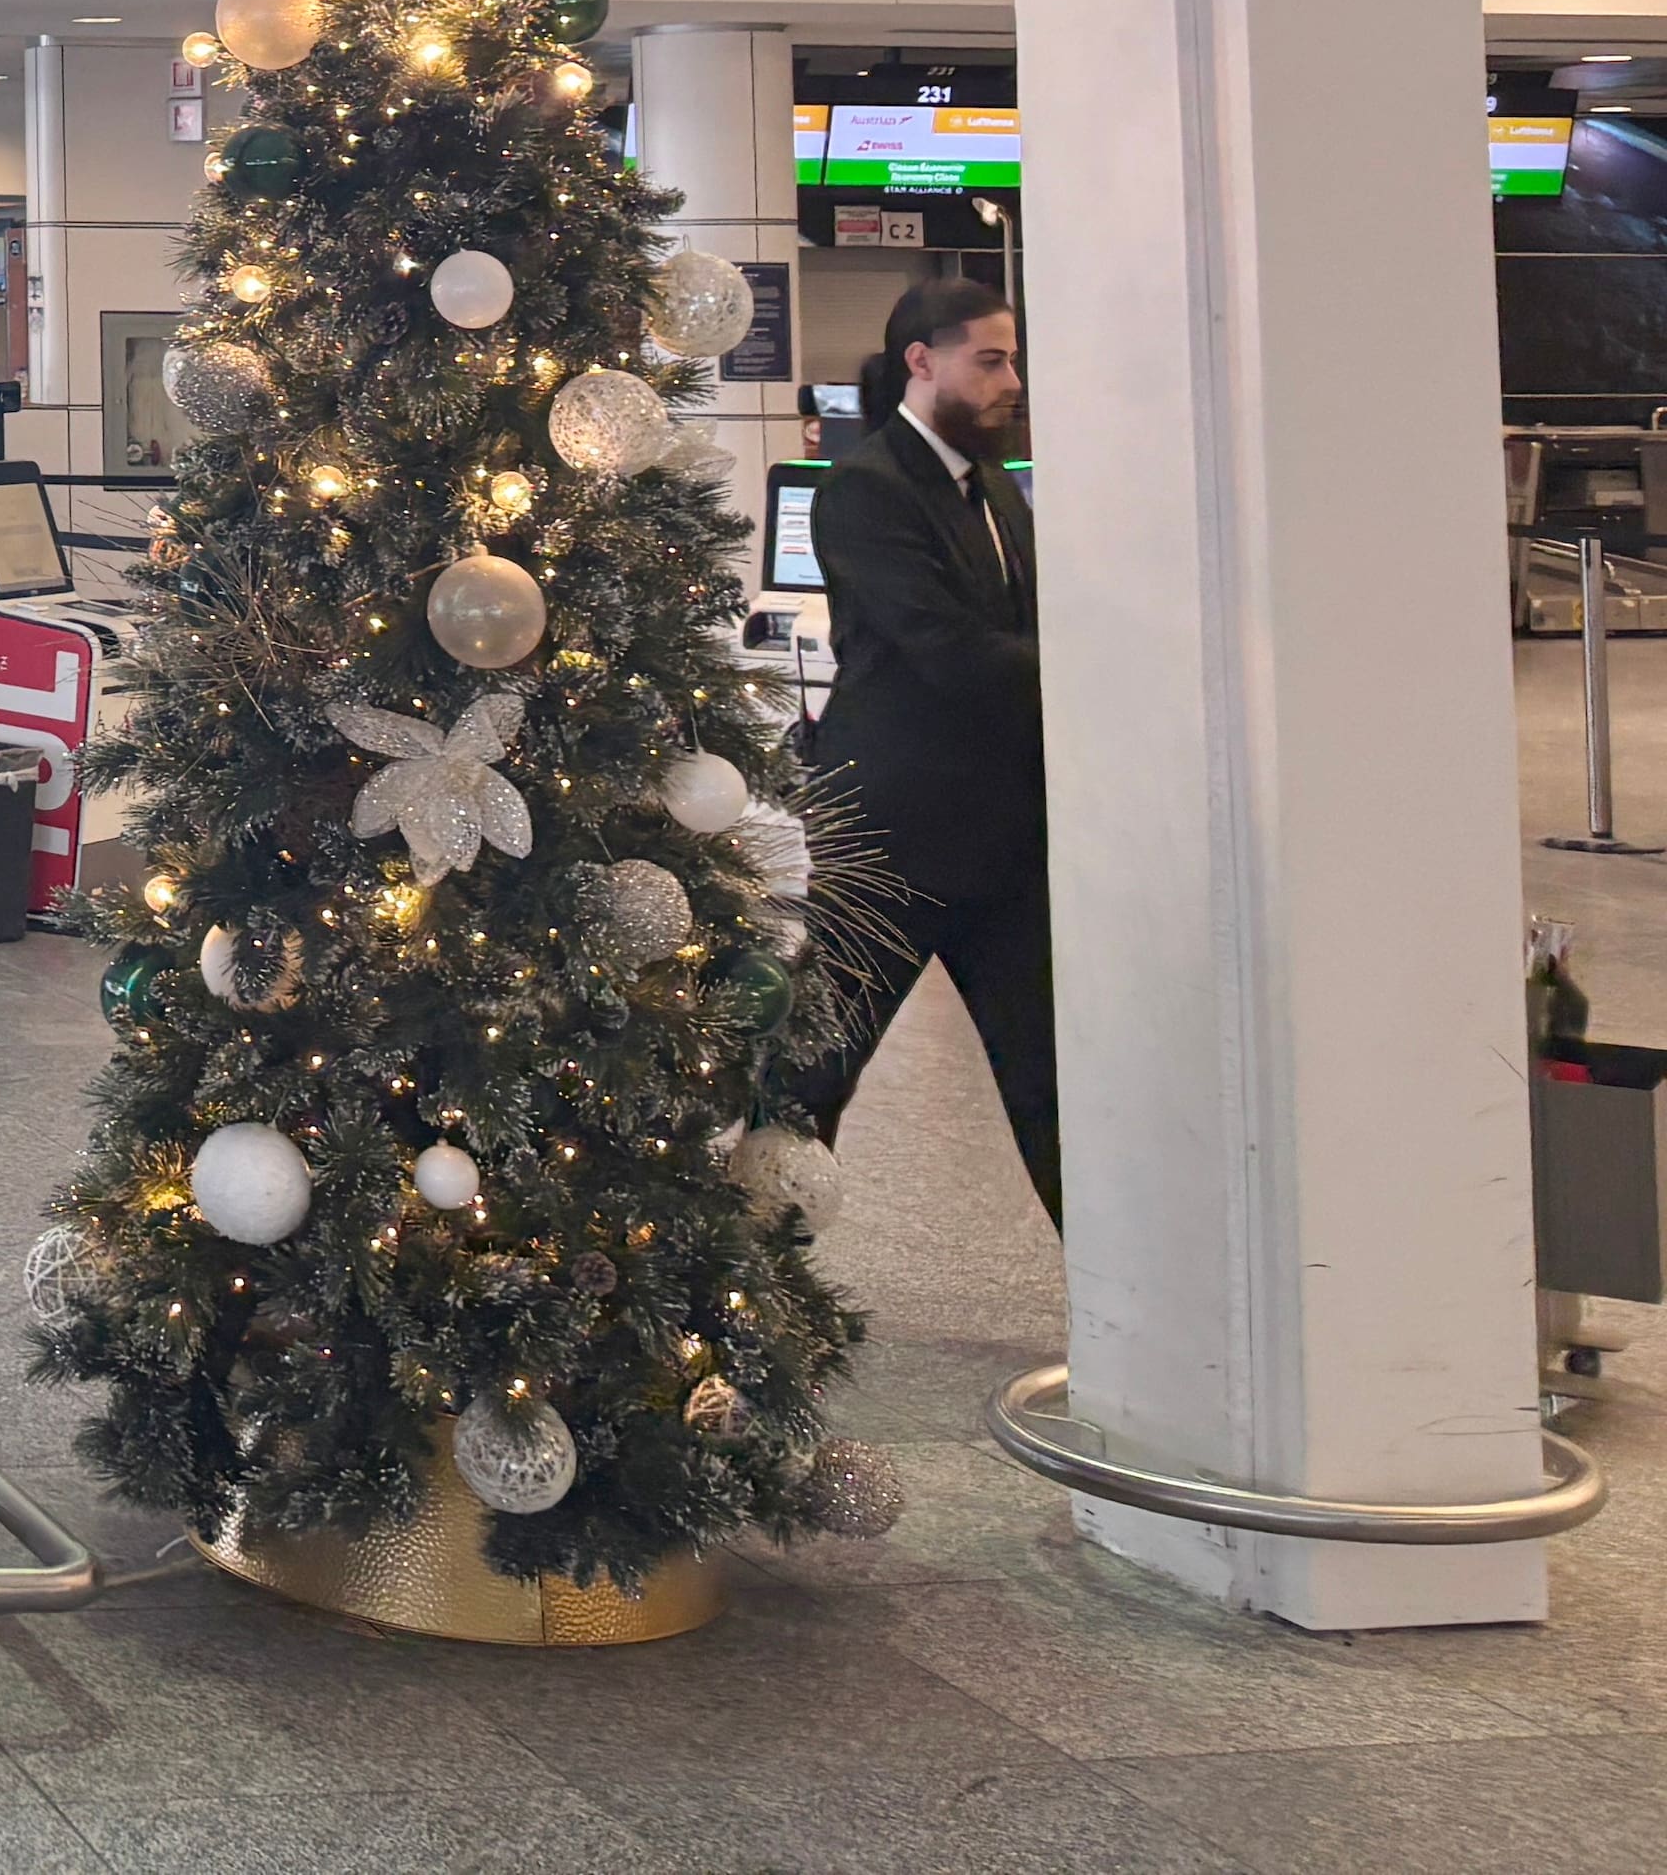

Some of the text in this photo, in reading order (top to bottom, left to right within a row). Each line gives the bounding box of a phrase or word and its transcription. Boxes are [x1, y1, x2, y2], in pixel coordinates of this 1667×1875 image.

[917, 86, 952, 103] 231
[890, 224, 915, 239] C 2
